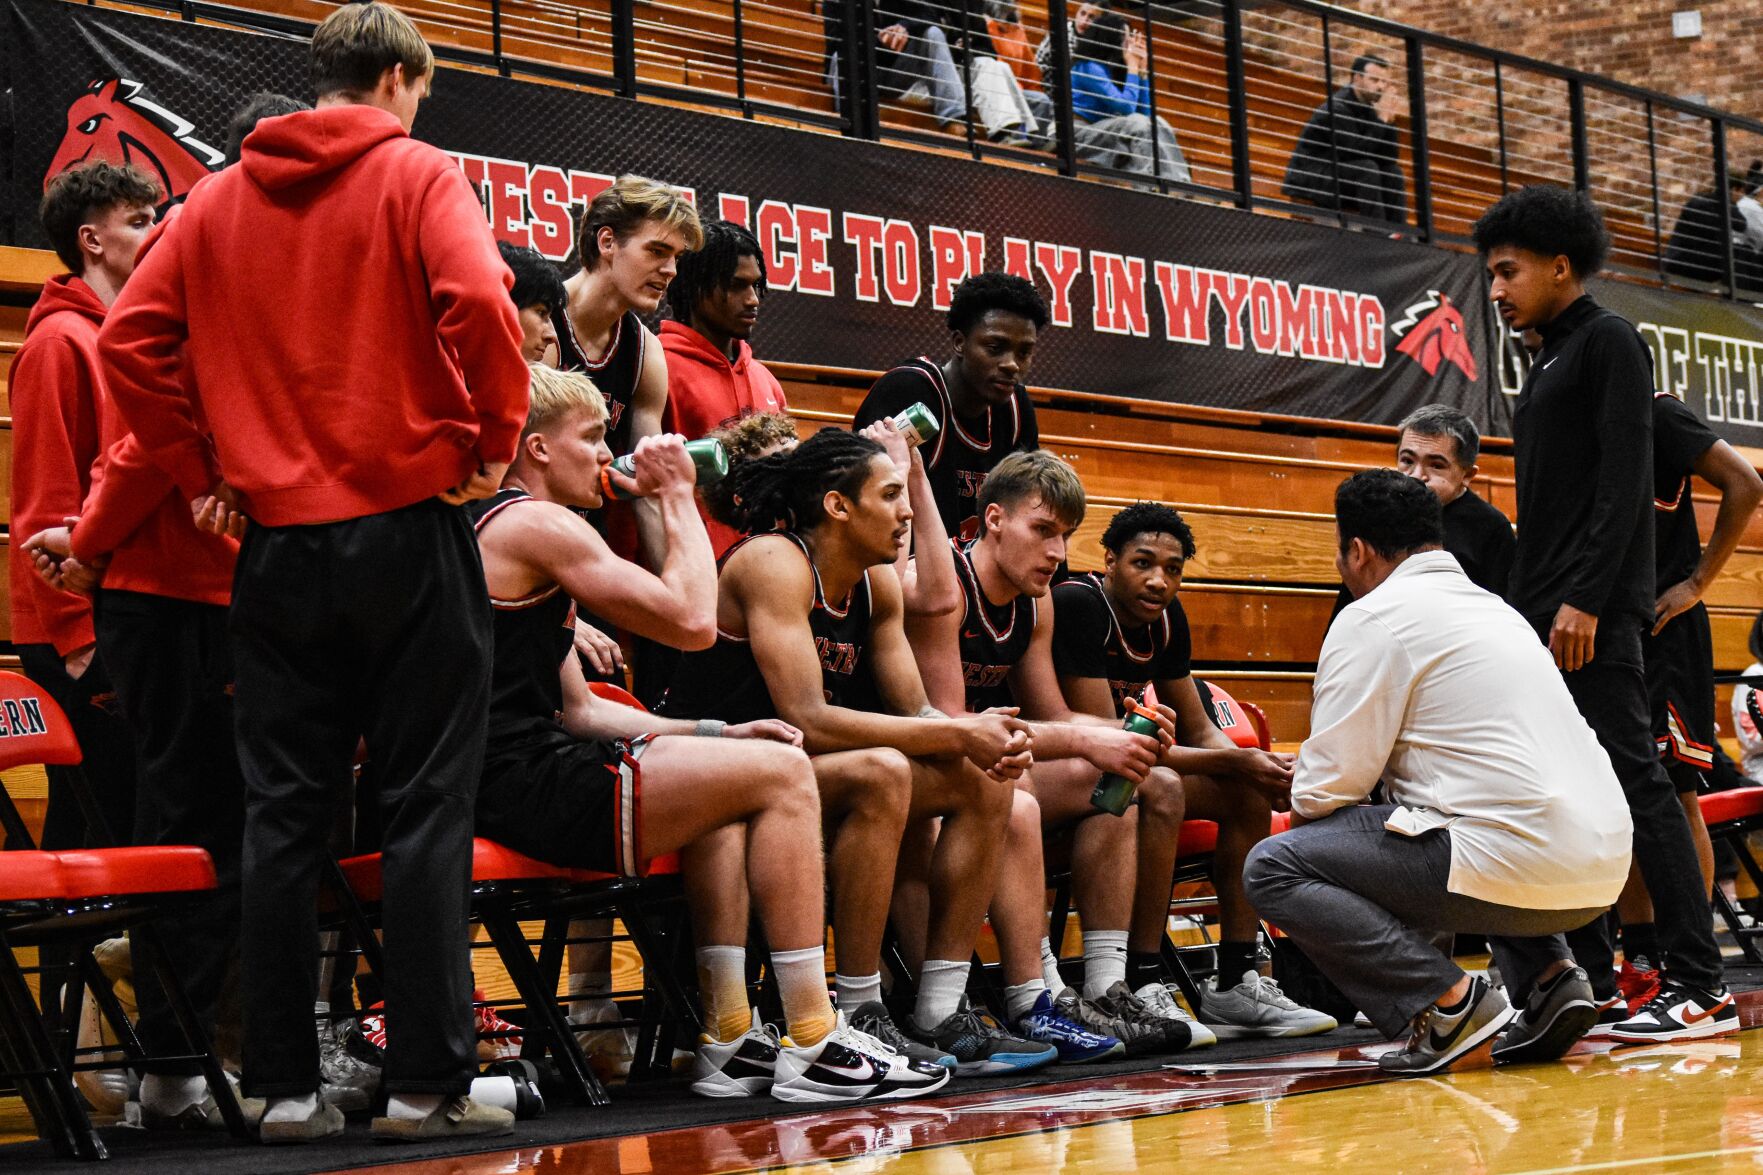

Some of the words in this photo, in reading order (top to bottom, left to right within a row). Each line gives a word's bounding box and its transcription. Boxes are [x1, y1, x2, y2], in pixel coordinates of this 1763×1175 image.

[842, 211, 921, 307] TO
[1090, 250, 1149, 337] IN
[1154, 261, 1386, 369] WYOMING
[1695, 332, 1763, 427] TH
